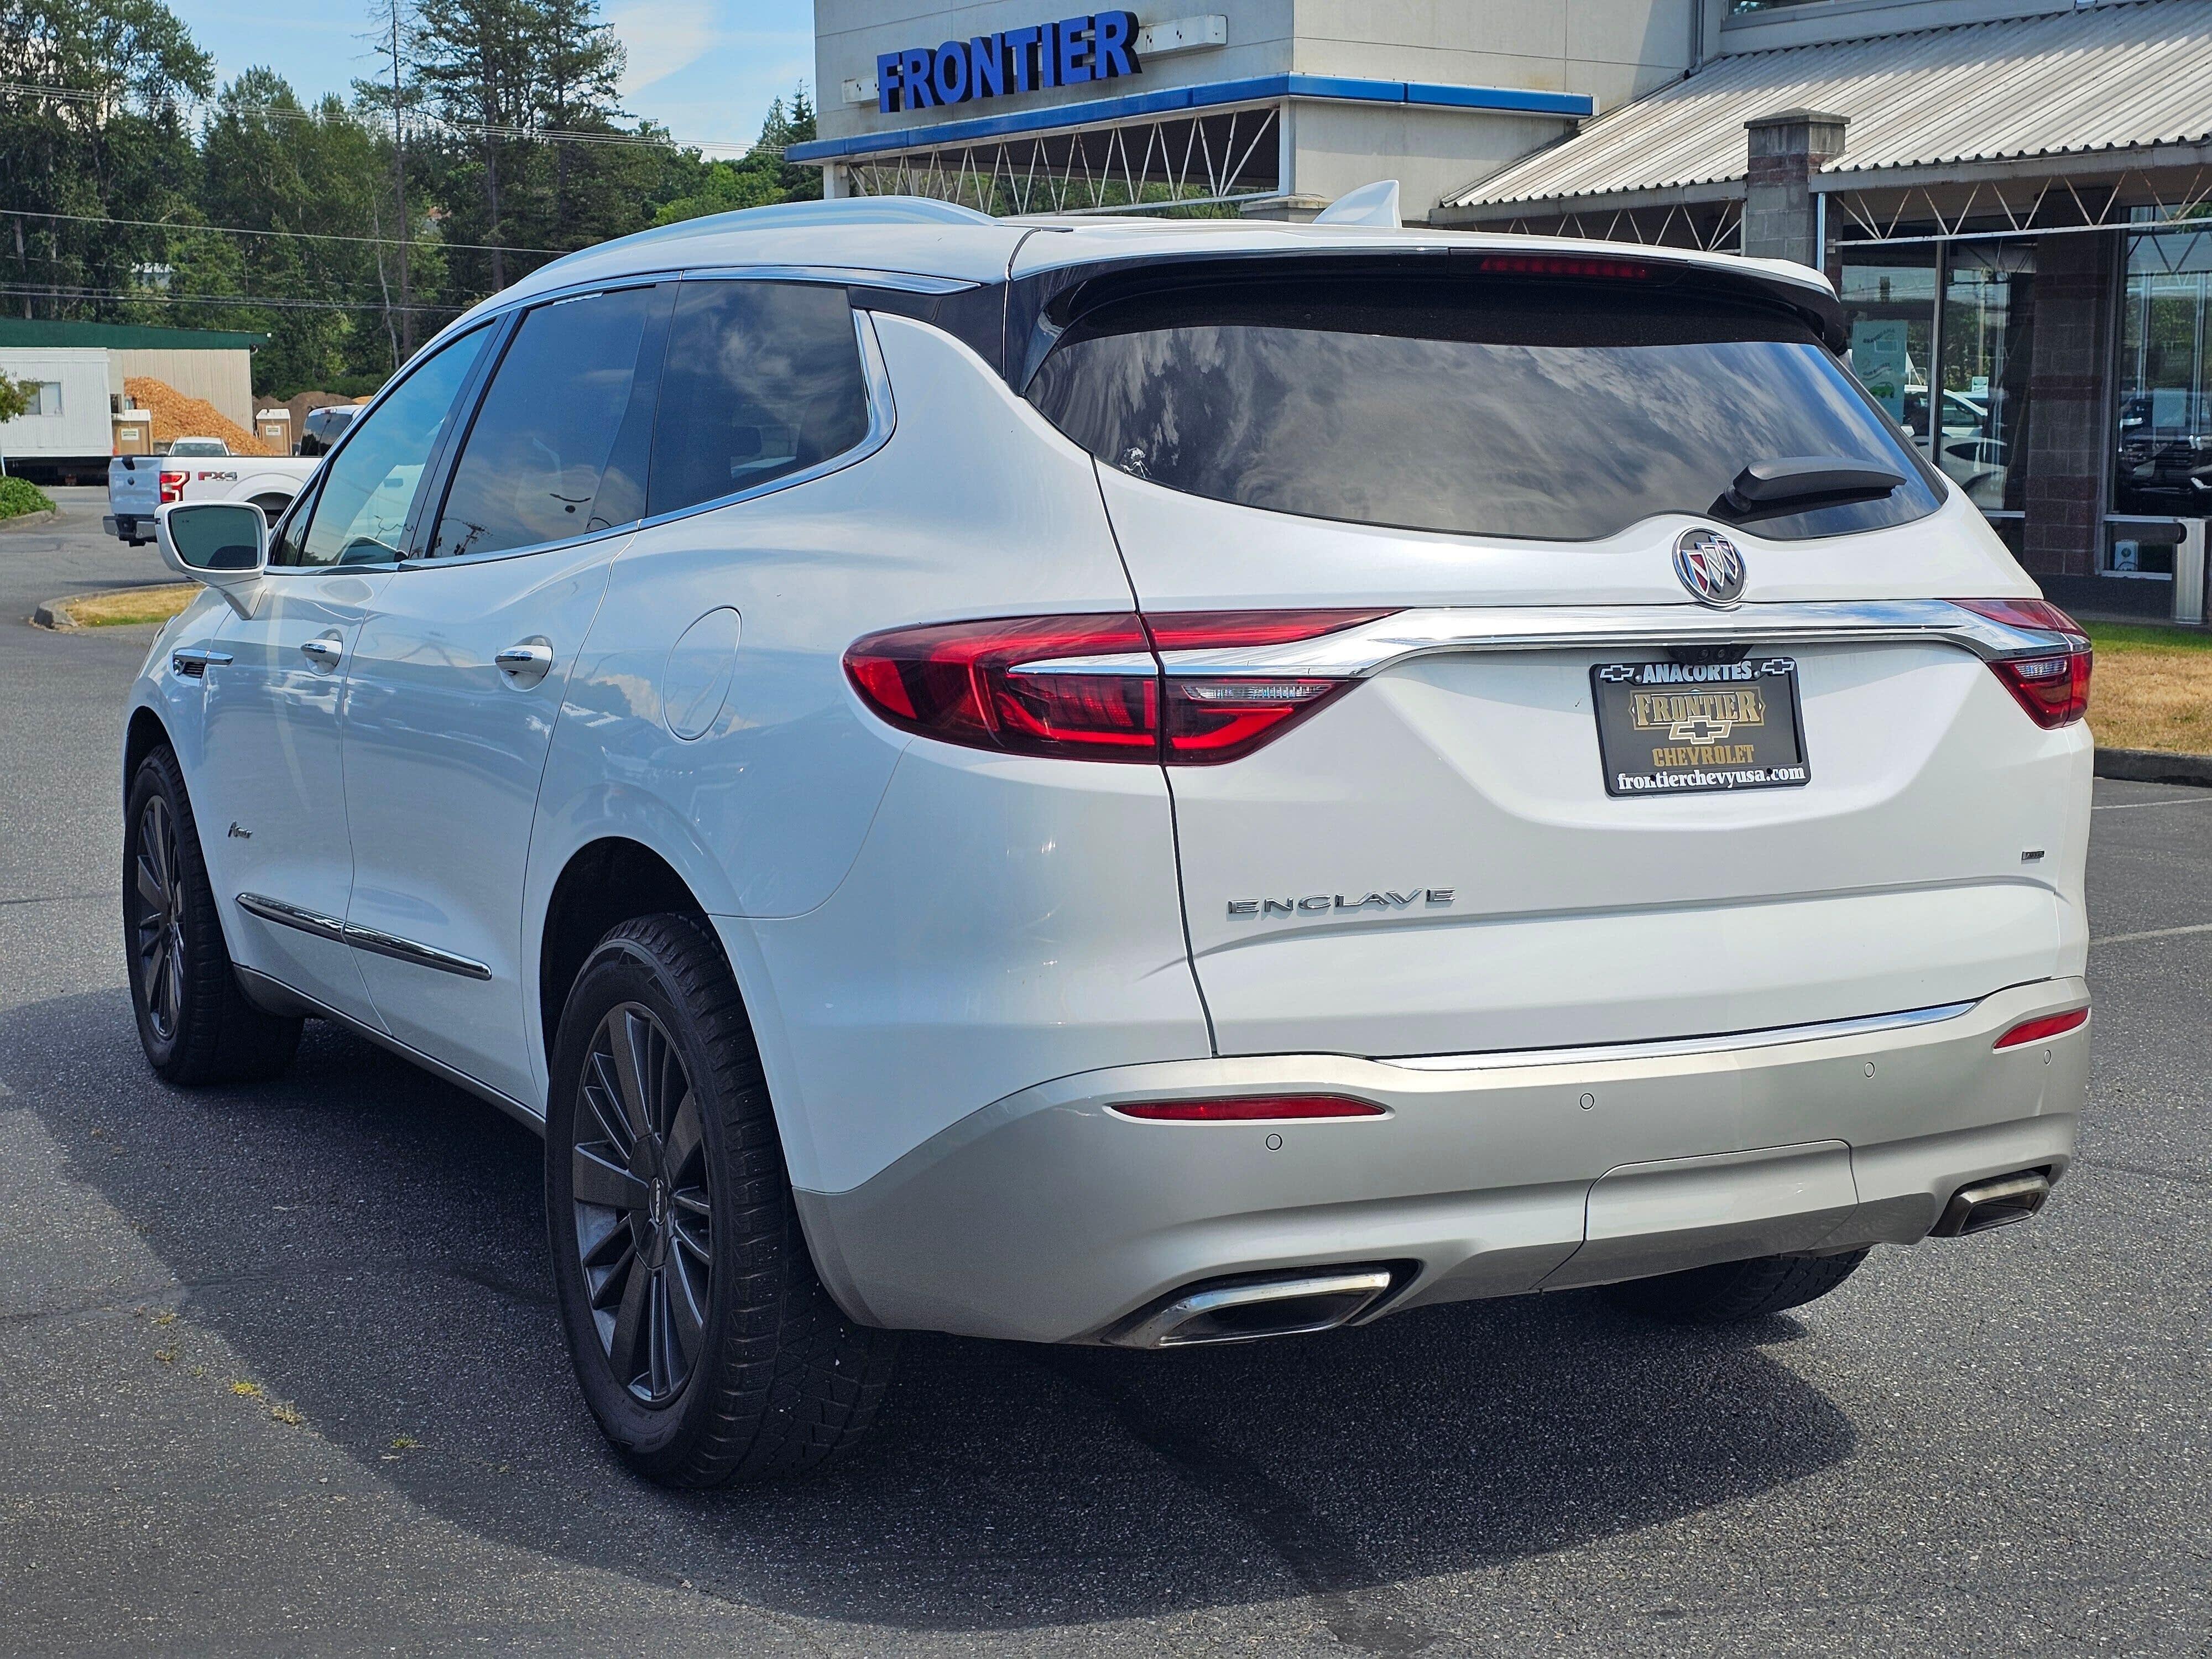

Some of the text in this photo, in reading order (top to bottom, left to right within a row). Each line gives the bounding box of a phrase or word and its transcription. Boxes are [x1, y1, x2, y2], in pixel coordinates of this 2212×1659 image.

[877, 10, 1142, 113] FRONTIER
[197, 471, 237, 481] FX4
[1642, 661, 1752, 684] ANACORTES
[1634, 690, 1760, 726] FRONTIER
[1651, 744, 1754, 766] CHEVROLET
[1618, 767, 1806, 788] frontierchevyusa.com
[1228, 887, 1455, 914] ENCLAVE
